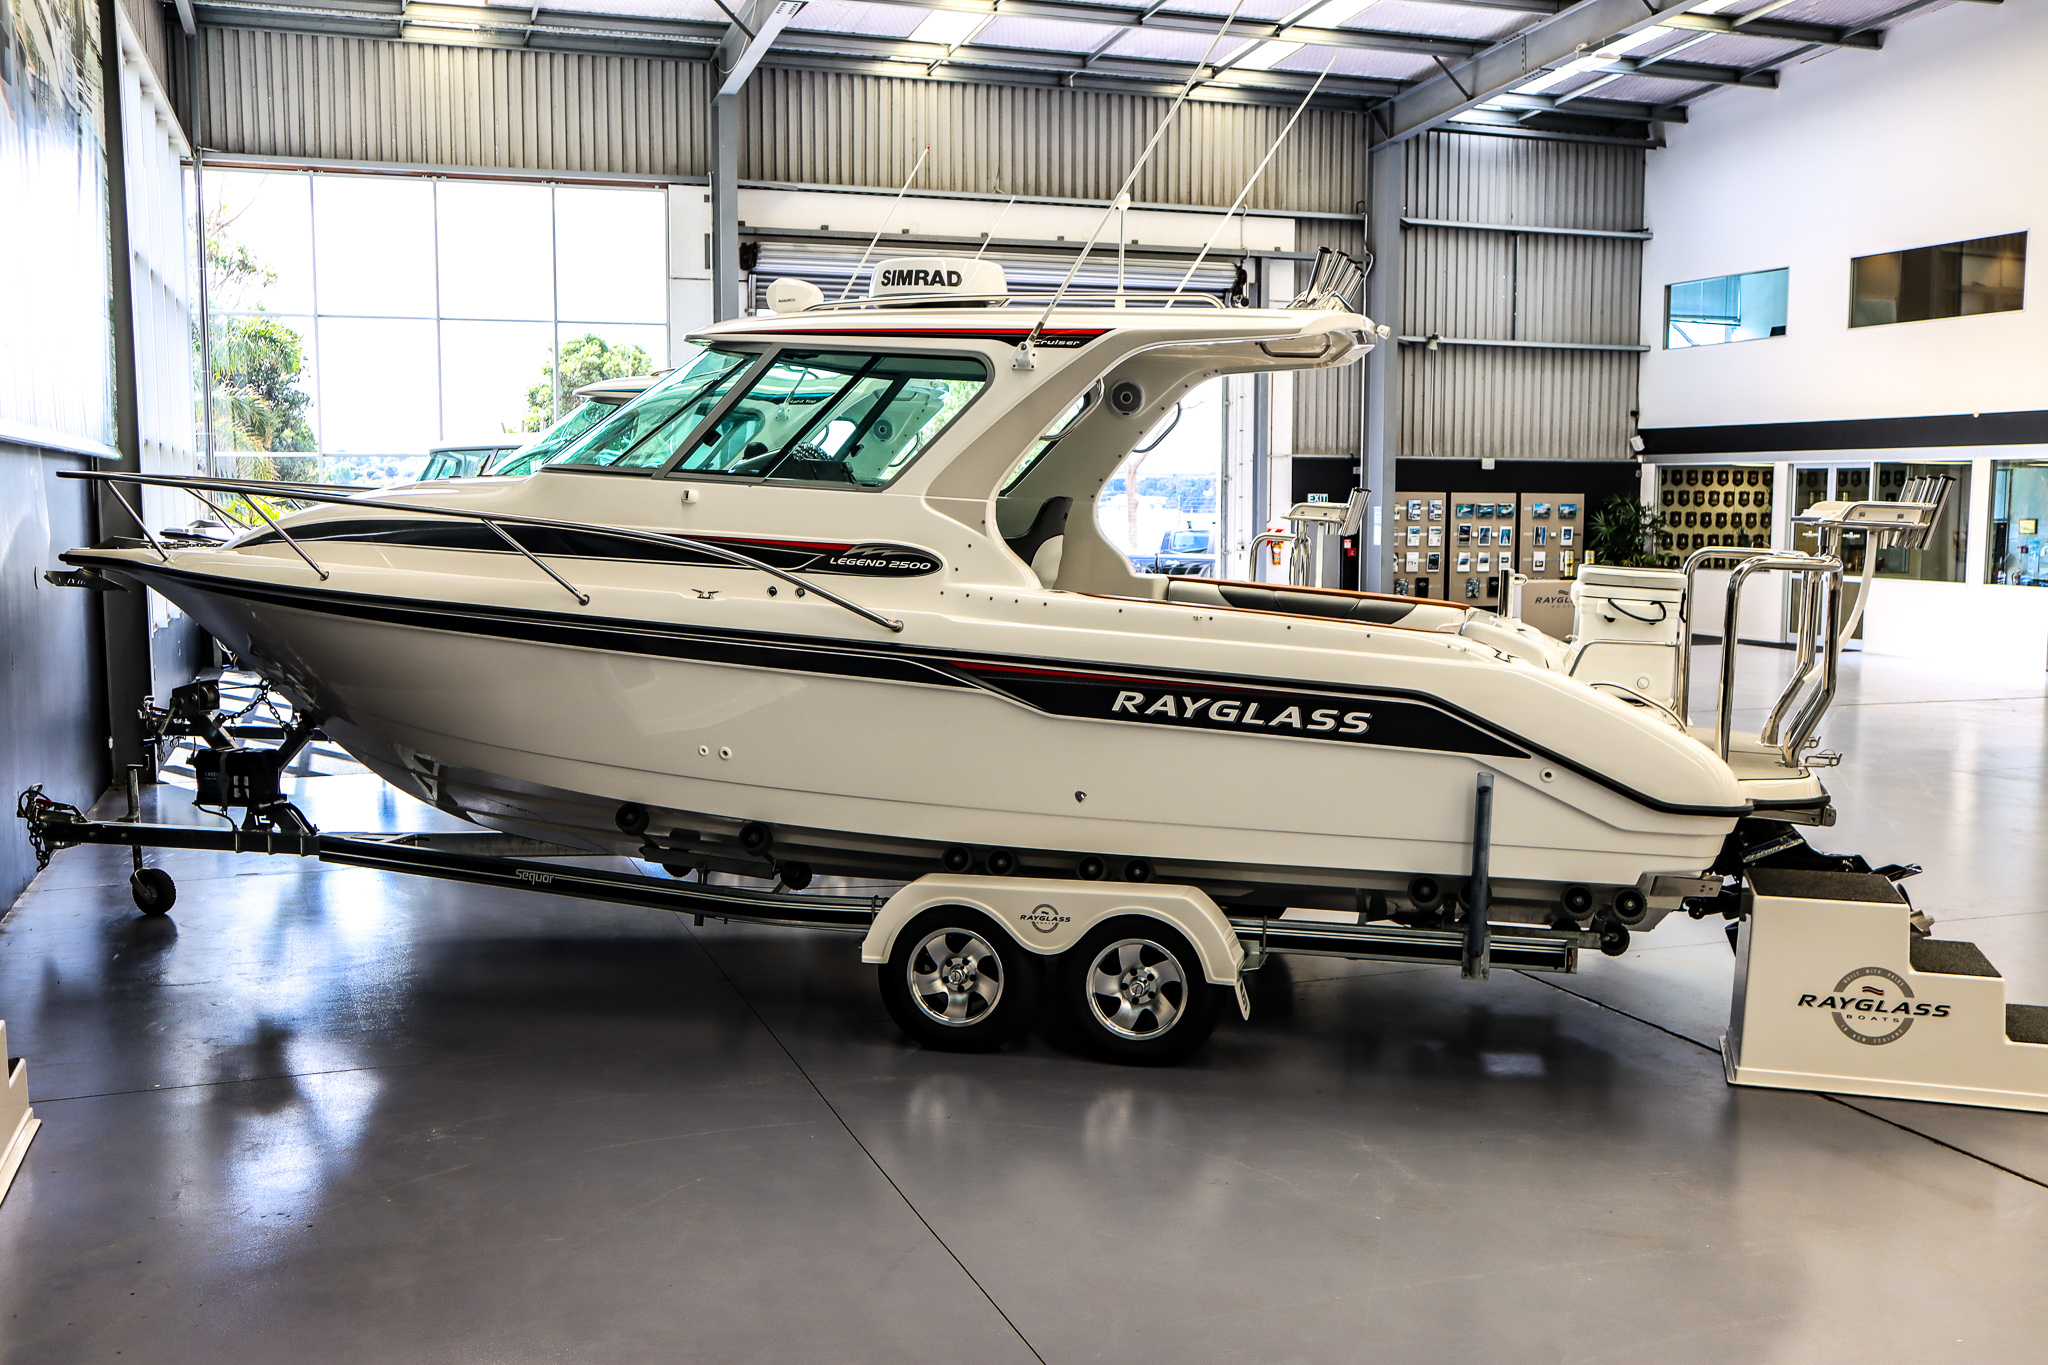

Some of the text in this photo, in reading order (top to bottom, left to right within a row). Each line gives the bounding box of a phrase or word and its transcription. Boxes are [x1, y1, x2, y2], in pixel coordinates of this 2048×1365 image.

[880, 269, 962, 287] SIMRAD
[1309, 495, 1328, 503] EXIT
[829, 557, 931, 570] LEGEND 2500
[1534, 596, 1573, 604] RAYGL
[1111, 690, 1373, 734] RAYGLASS
[515, 868, 555, 885] Sequor
[1019, 914, 1071, 923] RAYGLASS
[1797, 993, 1952, 1018] RAYGLASS
[1846, 1014, 1900, 1023] BOATS
